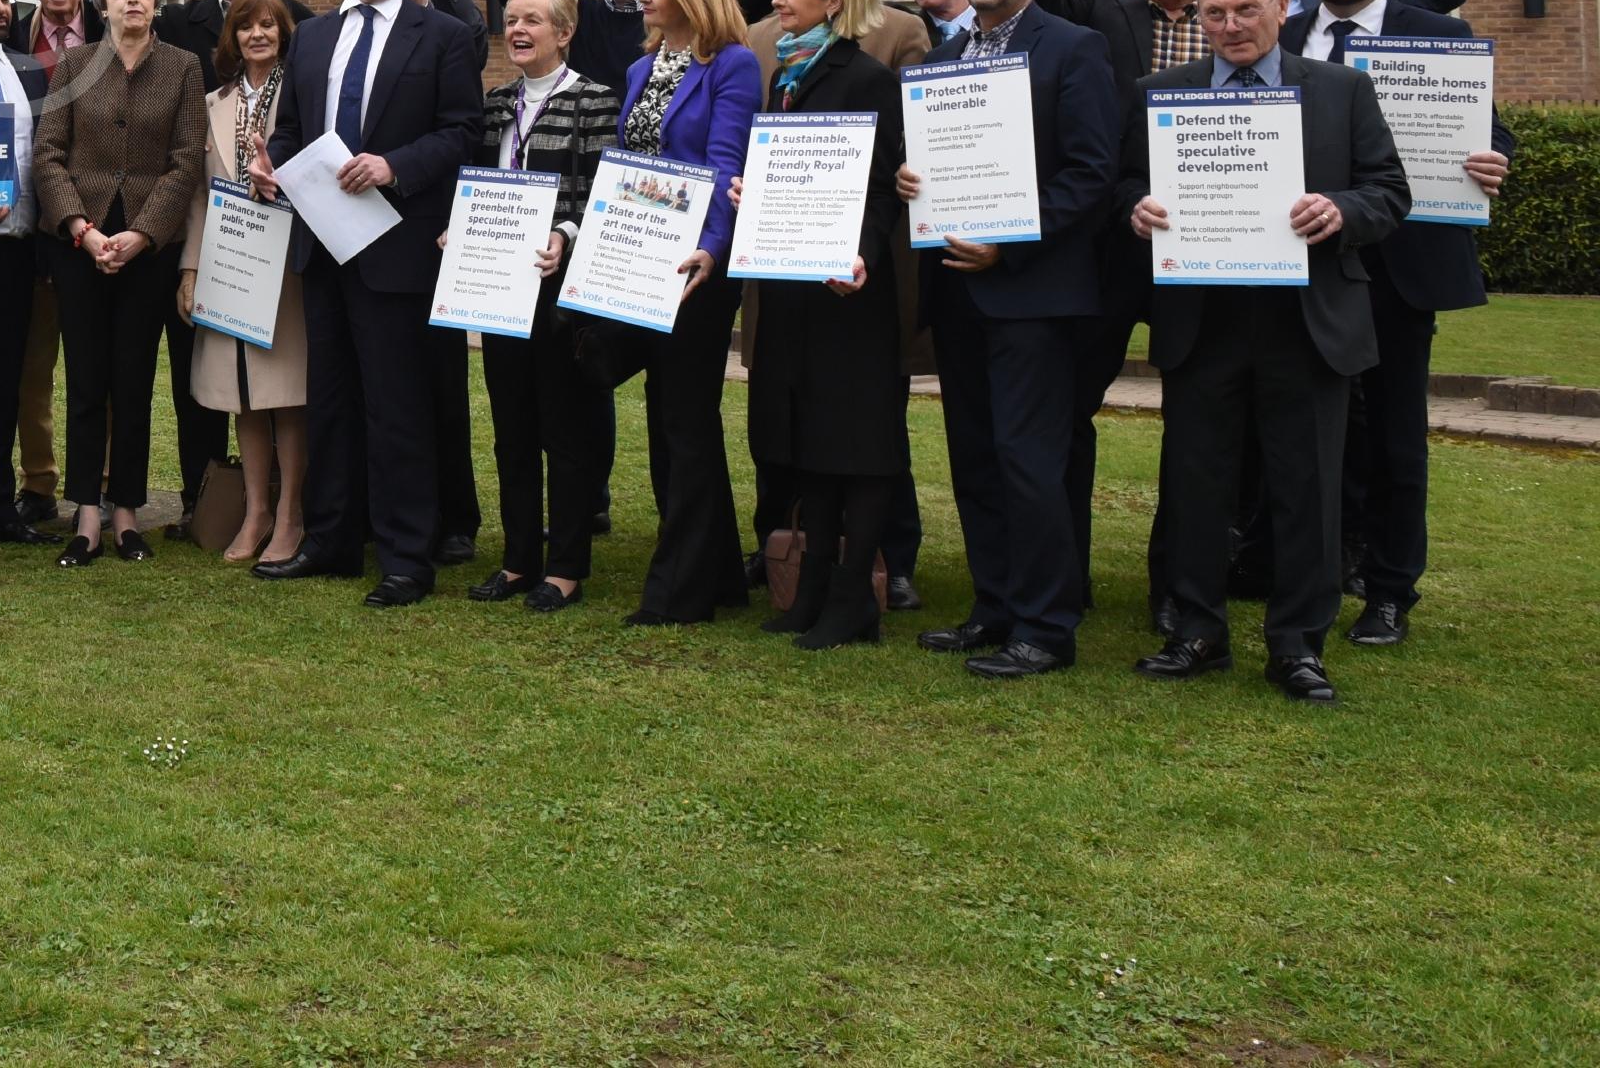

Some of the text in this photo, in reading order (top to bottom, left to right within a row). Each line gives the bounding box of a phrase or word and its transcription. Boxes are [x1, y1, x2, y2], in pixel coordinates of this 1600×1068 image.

[1372, 60, 1425, 75] Building
[1372, 75, 1487, 89] affordable homes
[925, 82, 988, 98] Protect the
[1152, 93, 1173, 101] OUR
[1174, 92, 1215, 100] PLEDGES
[1258, 90, 1295, 98] FUTURE
[1376, 91, 1478, 104] or our residents
[926, 97, 987, 112] vulnerable
[1176, 114, 1252, 126] Defend the
[772, 133, 850, 144] A sustainable,
[1176, 129, 1279, 144] greenbelt from
[770, 147, 862, 159] environmentally
[1177, 144, 1256, 159] speculative
[768, 159, 845, 172] friendly Royal
[1178, 161, 1269, 175] development
[766, 173, 814, 185] Borough
[1178, 183, 1259, 191] Support neighbourhood
[473, 188, 523, 202] Defend the
[1178, 192, 1208, 200] planning
[471, 203, 538, 216] greenbelt from
[607, 204, 667, 225] State of the
[1201, 209, 1234, 217] greenbelt
[468, 215, 520, 227] speculative
[466, 226, 526, 241] development
[603, 219, 681, 242] art new leisure
[1199, 226, 1249, 234] collaboratively
[600, 230, 643, 248] facilities
[1202, 235, 1232, 243] Councils
[1182, 259, 1302, 271] Vote Conservative
